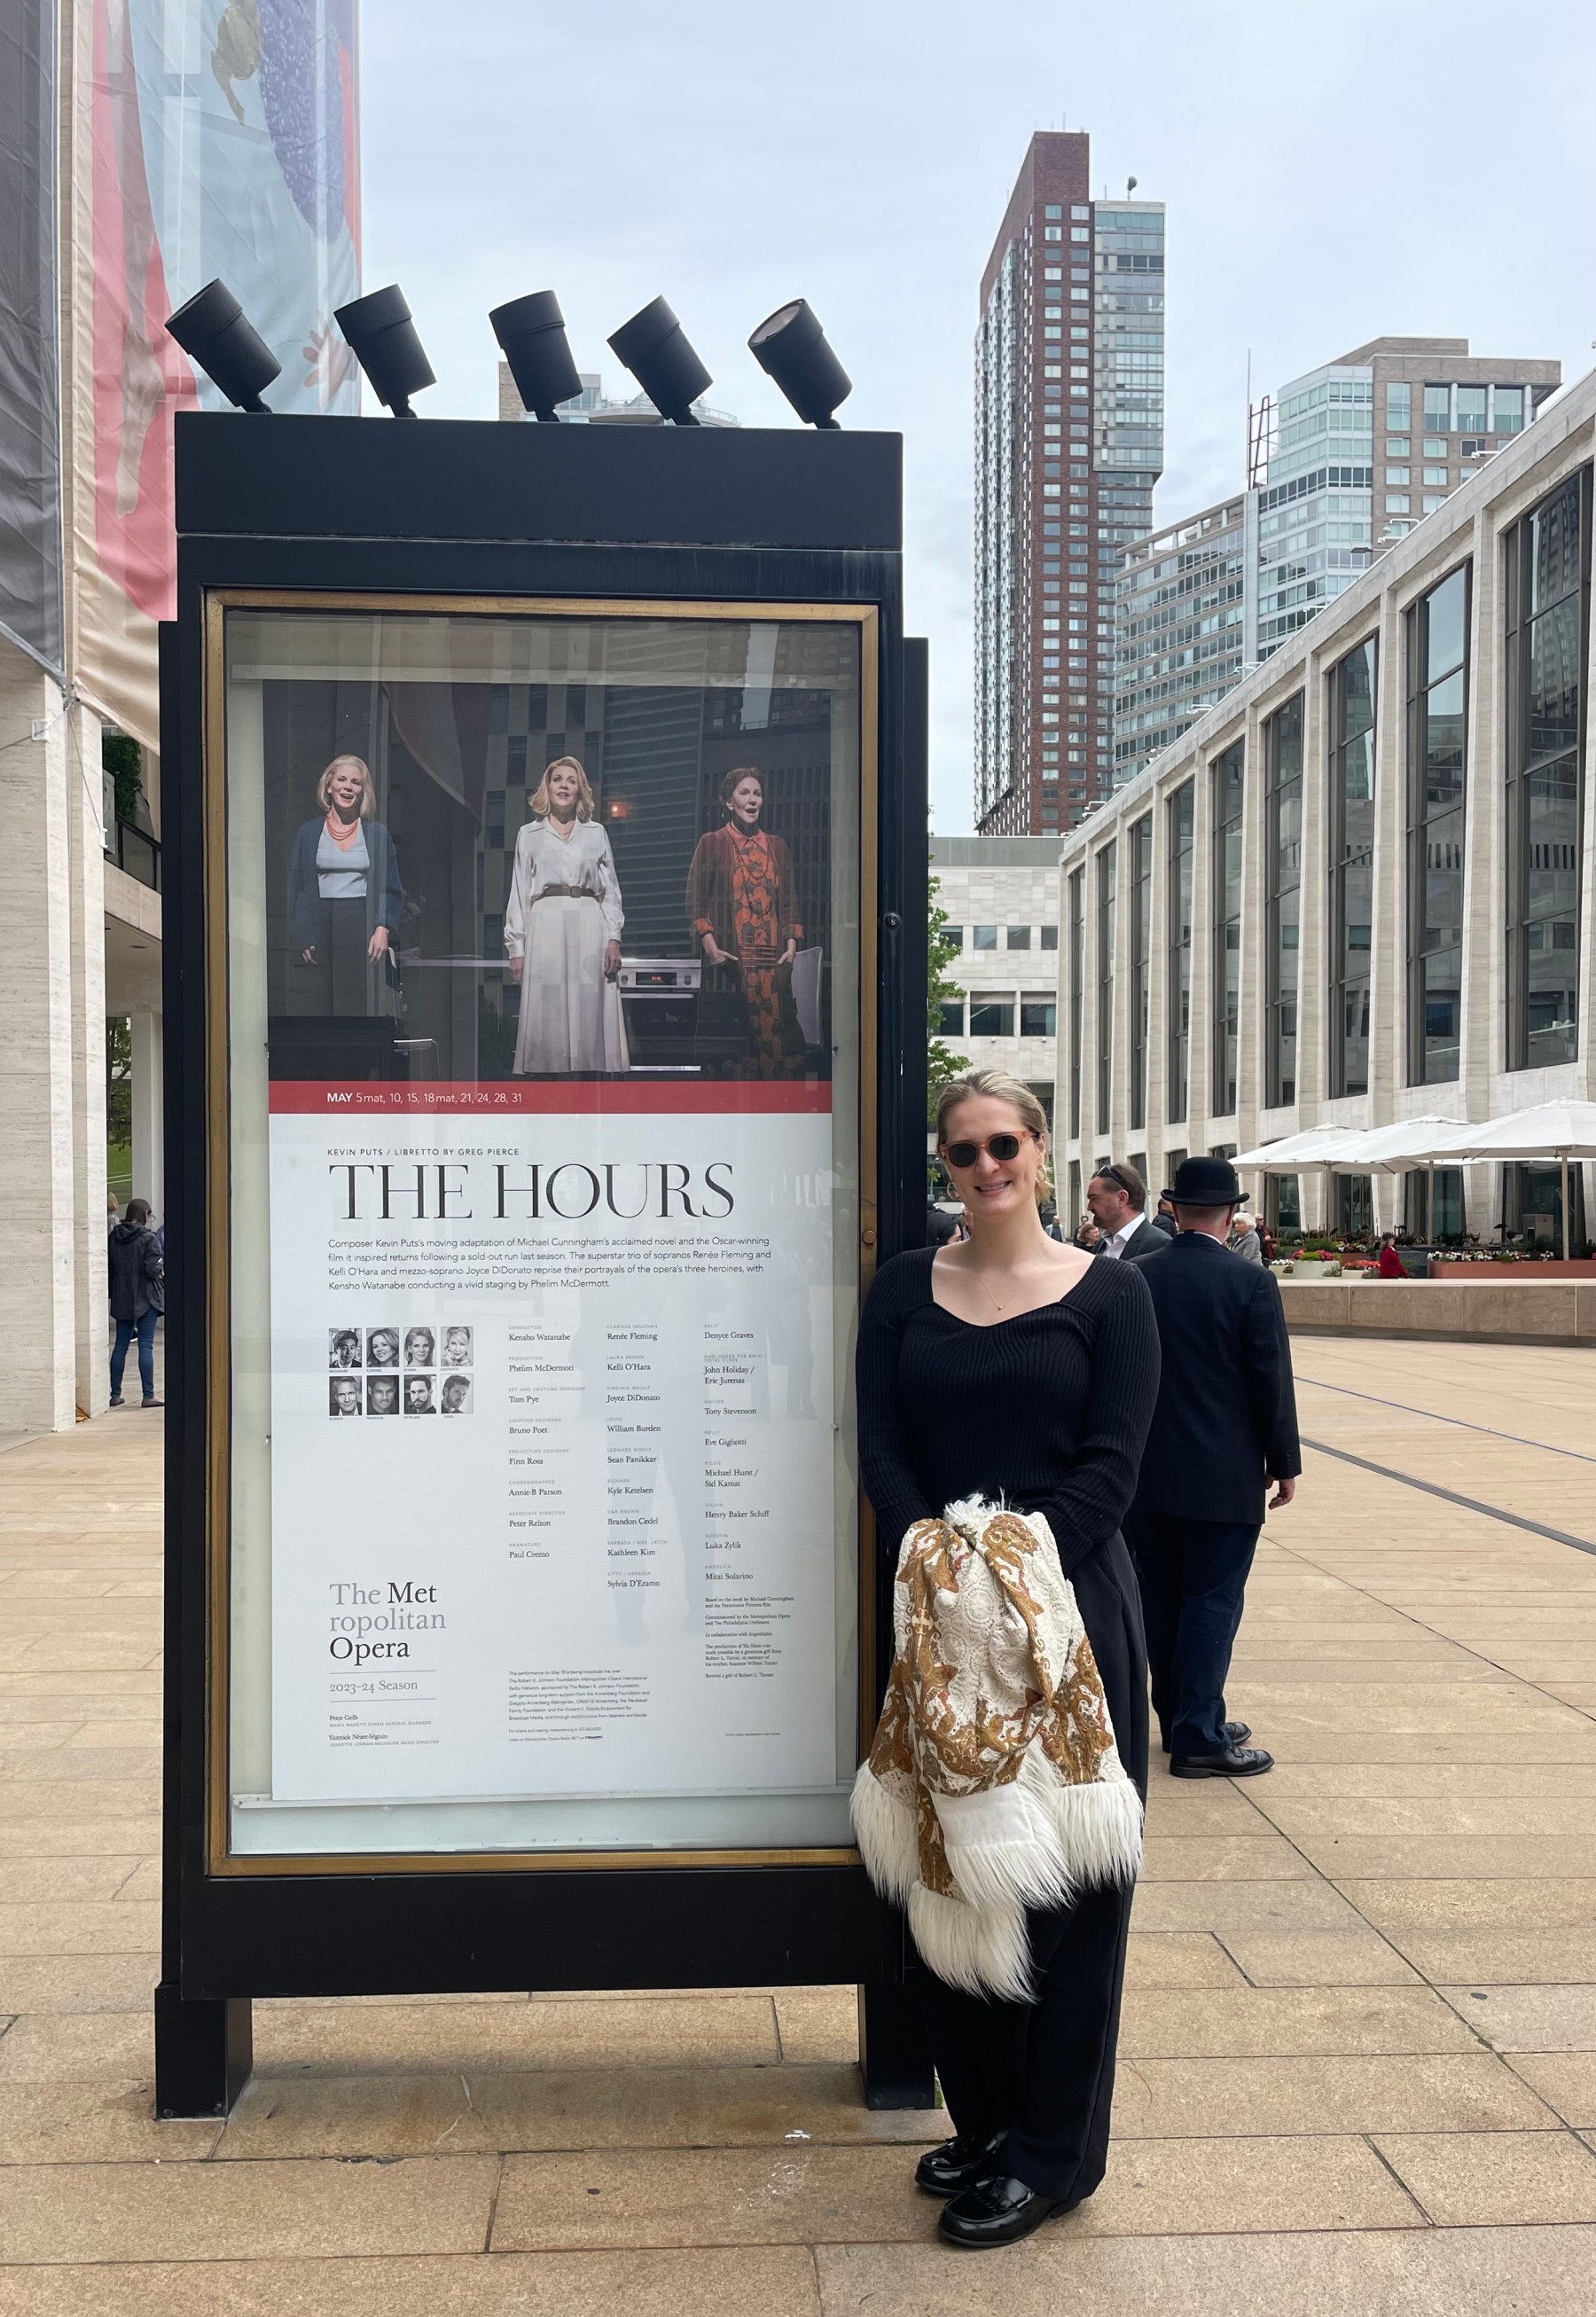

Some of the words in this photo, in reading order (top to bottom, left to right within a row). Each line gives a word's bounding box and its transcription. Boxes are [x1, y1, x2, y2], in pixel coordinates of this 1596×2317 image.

[327, 1092, 353, 1102] MAY
[390, 1092, 403, 1103] 10,
[407, 1092, 419, 1103] 15,
[424, 1092, 457, 1103] 18mat,
[460, 1092, 474, 1103] 21,
[477, 1092, 490, 1103] 24,
[494, 1092, 508, 1103] 28,
[512, 1092, 521, 1102] 31
[329, 1164, 472, 1219] THE
[492, 1162, 733, 1218] HOURS
[328, 1239, 372, 1249] Composer
[426, 1239, 458, 1249] moving
[459, 1238, 504, 1248] adaptation
[506, 1237, 515, 1246] of
[517, 1237, 549, 1246] Michael
[552, 1237, 609, 1248] Cunningham's
[678, 1236, 693, 1245] and
[711, 1236, 769, 1247] Oscar-winning
[354, 1253, 387, 1263] inspired
[420, 1251, 458, 1263] following
[467, 1251, 502, 1260] sold-out
[520, 1251, 534, 1260] last
[587, 1252, 625, 1261] superstar
[643, 1250, 652, 1259] of
[653, 1252, 691, 1261] sopranos
[721, 1249, 753, 1260] Fleming
[755, 1249, 771, 1258] and
[380, 1266, 396, 1275] and
[399, 1268, 463, 1277] mezzo-soprano
[466, 1266, 489, 1276] Joyce
[534, 1265, 561, 1275] reprise
[584, 1264, 624, 1275] portrayals
[627, 1264, 635, 1272] of
[653, 1264, 682, 1274] opera's
[708, 1264, 744, 1273] heroines,
[362, 1280, 405, 1289] Watanabe
[408, 1280, 455, 1290] conducting
[485, 1280, 516, 1290] staging
[518, 1280, 528, 1290] by
[530, 1279, 558, 1288] Phelim
[560, 1279, 610, 1288] McDermott.
[630, 1332, 657, 1341] Fleming
[704, 1331, 729, 1340] Denyce
[703, 1366, 721, 1375] John
[722, 1366, 749, 1375] Holiday
[526, 1395, 539, 1405] Pye
[606, 1394, 624, 1403] Joyce
[704, 1407, 721, 1416] Tony
[607, 1487, 622, 1496] Kyle
[607, 1579, 627, 1589] Sylvia
[330, 1582, 379, 1605] The
[387, 1581, 436, 1603] Met
[330, 1608, 446, 1639] ropolitan
[330, 1637, 410, 1666] Opera
[379, 1679, 417, 1690] Season
